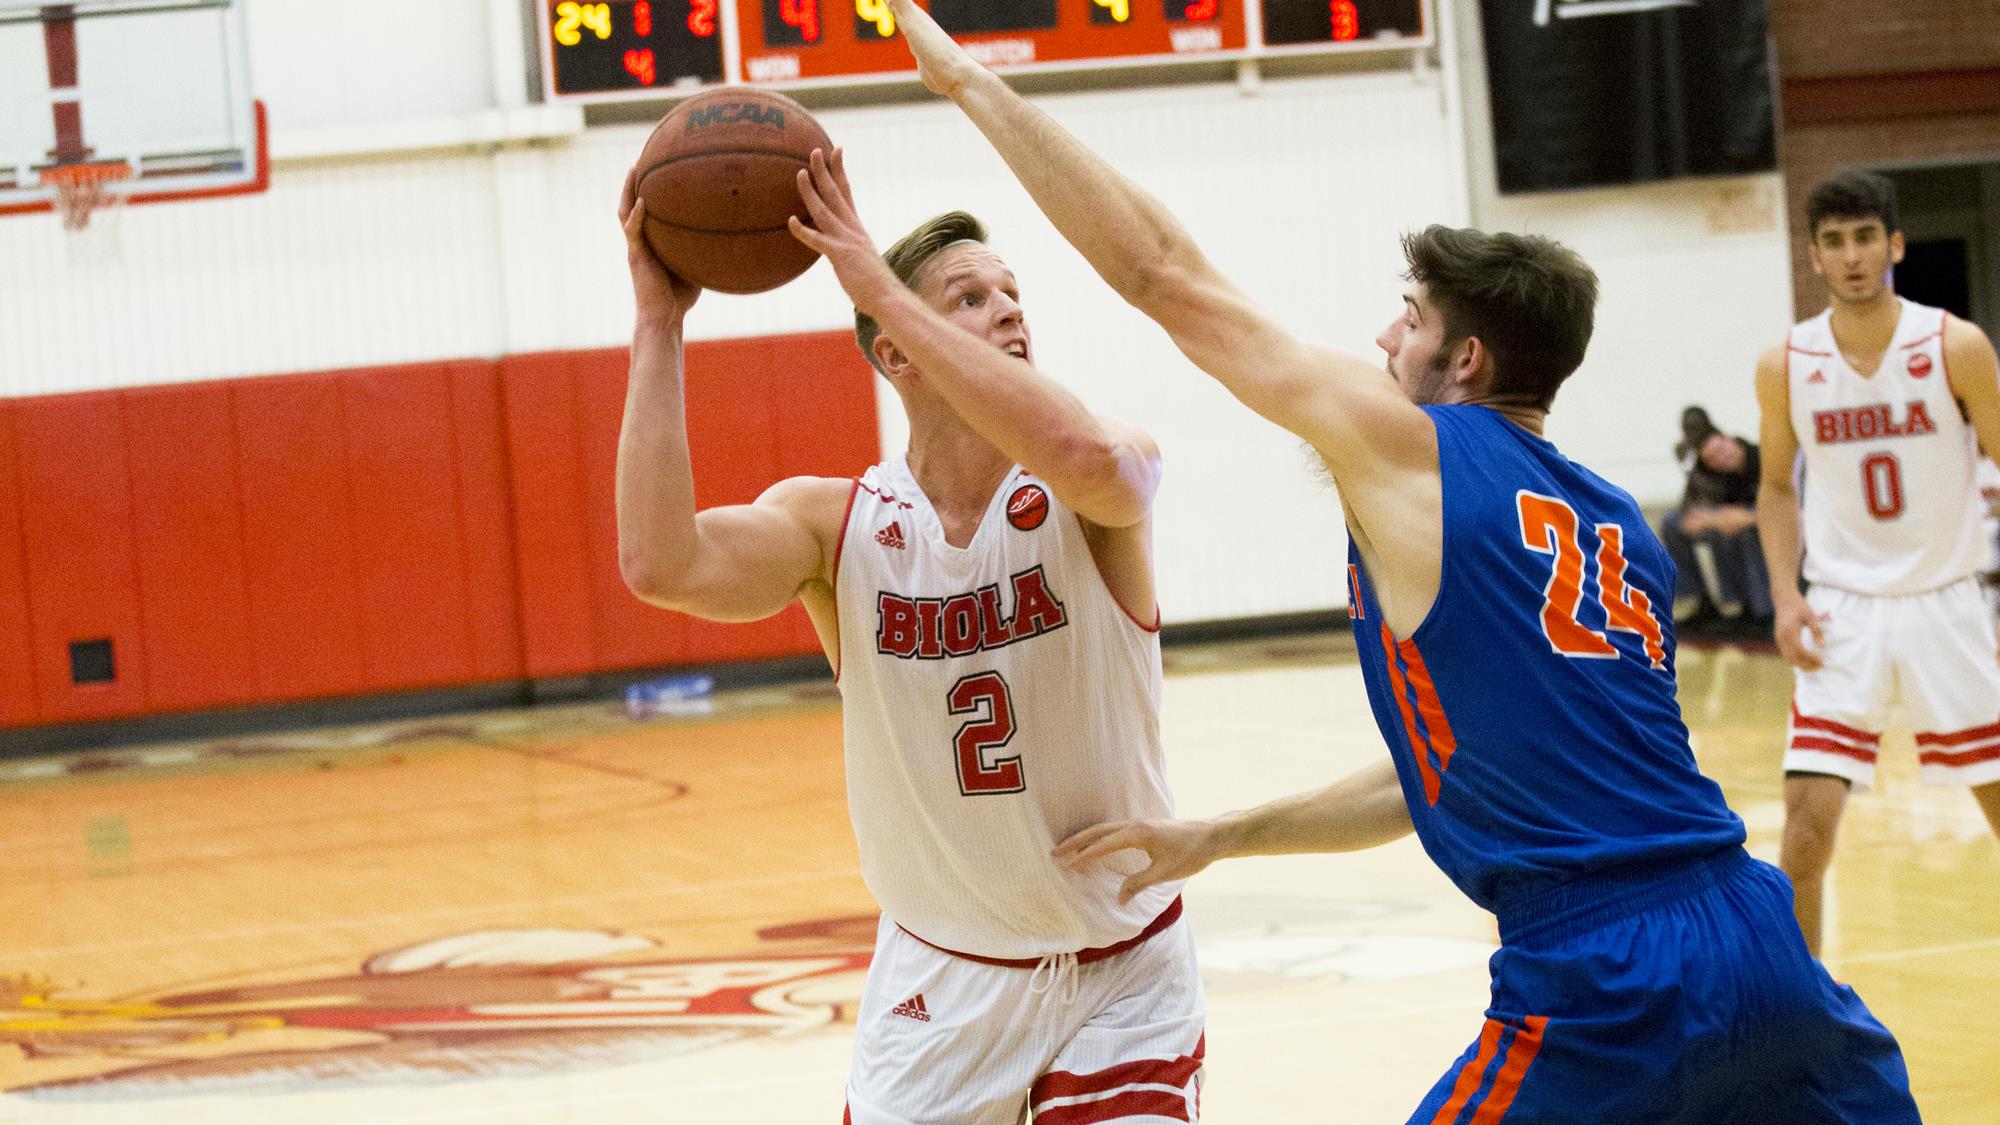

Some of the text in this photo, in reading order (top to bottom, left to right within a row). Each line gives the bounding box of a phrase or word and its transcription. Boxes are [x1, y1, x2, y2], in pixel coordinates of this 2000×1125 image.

[554, 1, 612, 46] 24
[687, 103, 784, 129] NCAA
[1813, 399, 1938, 445] BIOLA
[1860, 451, 1905, 522] 0
[1515, 488, 1667, 672] 24
[876, 563, 1069, 661] BIOLA
[947, 669, 1026, 797] 2
[892, 1007, 931, 1023] adidas
